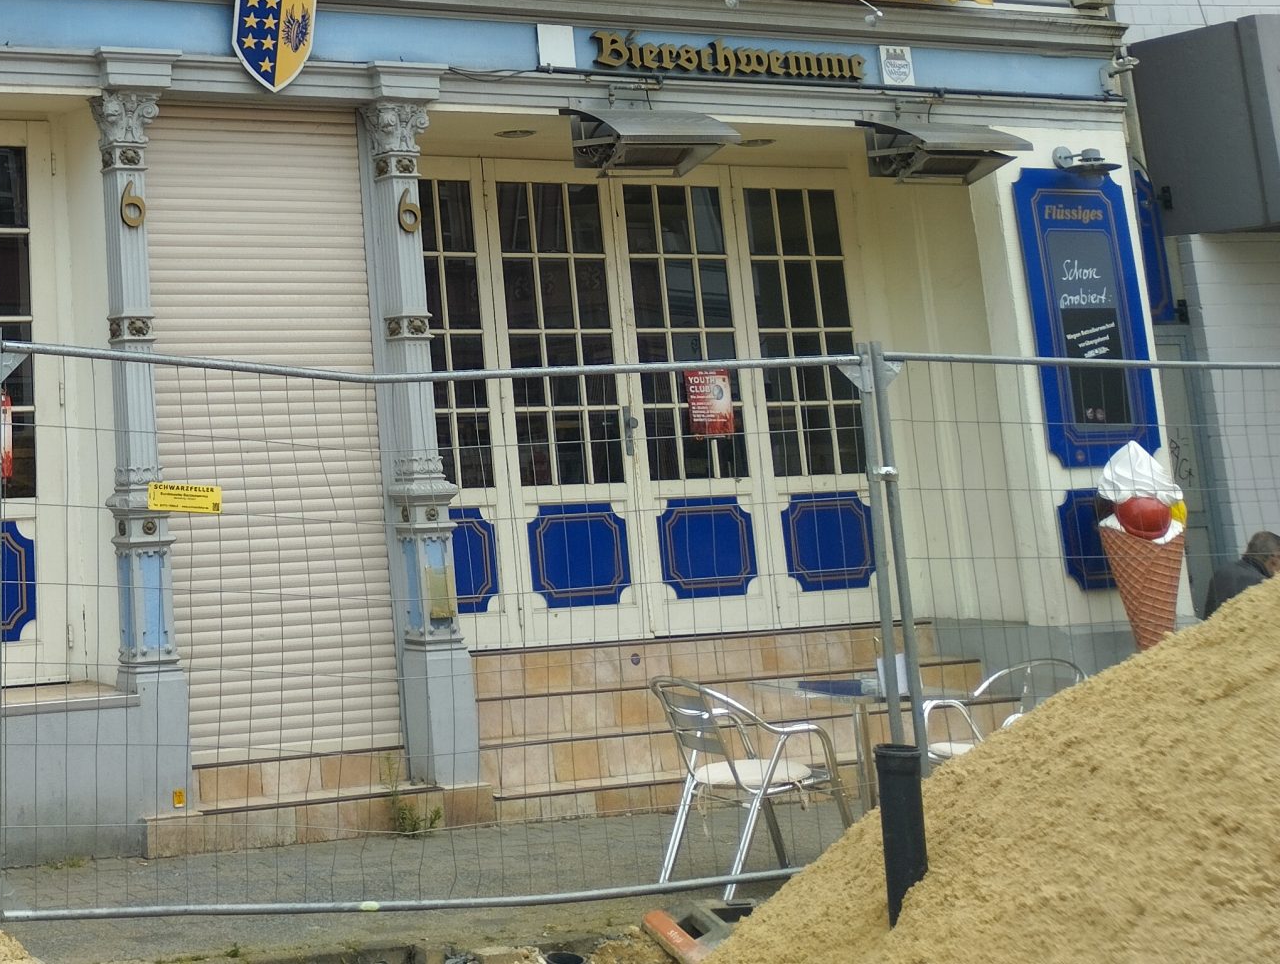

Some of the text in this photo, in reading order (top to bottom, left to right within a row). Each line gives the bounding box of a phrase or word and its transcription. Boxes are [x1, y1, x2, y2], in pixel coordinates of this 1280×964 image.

[593, 30, 867, 80] Bierschwemme
[1044, 204, 1104, 224] Flüssiges
[1061, 259, 1101, 281] Schon
[687, 376, 716, 384] YOUTH
[153, 483, 215, 493] SCHWARZFELLER
